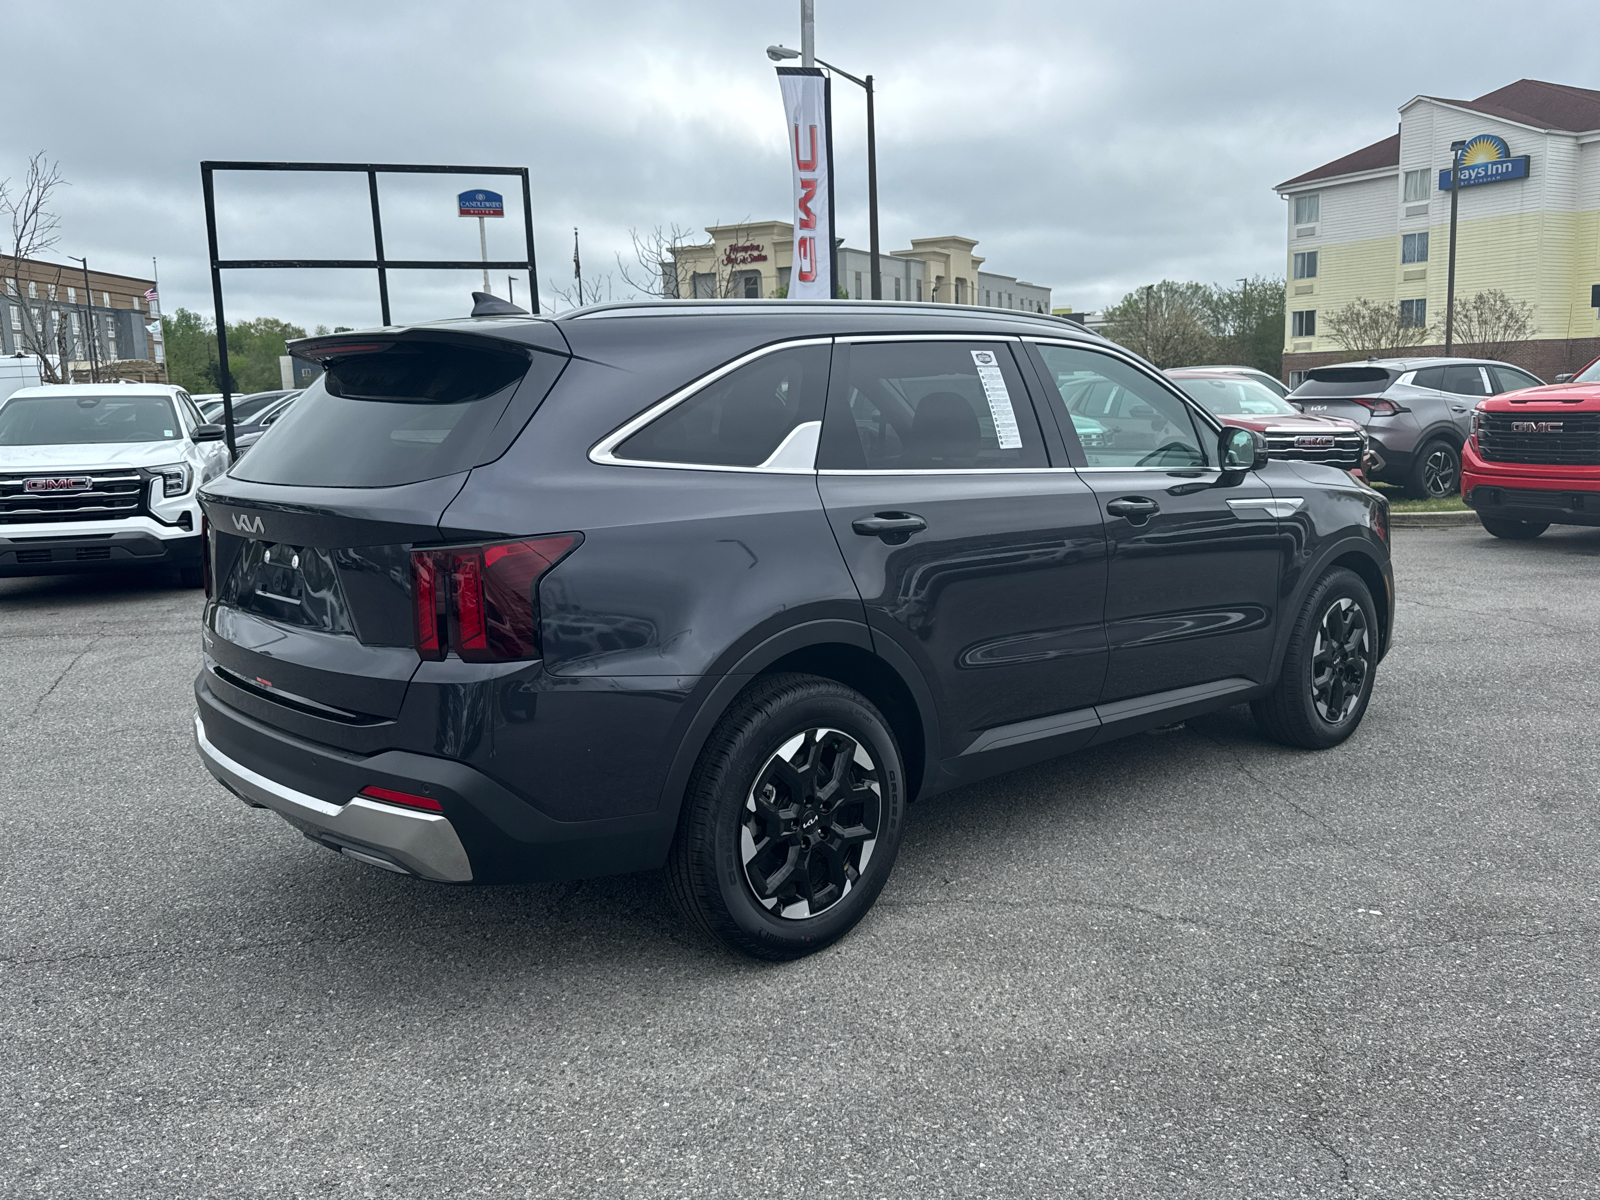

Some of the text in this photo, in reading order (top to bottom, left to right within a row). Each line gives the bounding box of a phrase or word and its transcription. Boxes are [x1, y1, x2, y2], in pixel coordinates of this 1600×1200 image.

[1487, 162, 1512, 175] Inn
[1470, 176, 1501, 184] WYNDHAM
[795, 123, 818, 282] GMC
[1511, 421, 1563, 433] GMC
[1299, 437, 1332, 446] GMC
[28, 478, 86, 491] GMC
[232, 513, 265, 534] KIA
